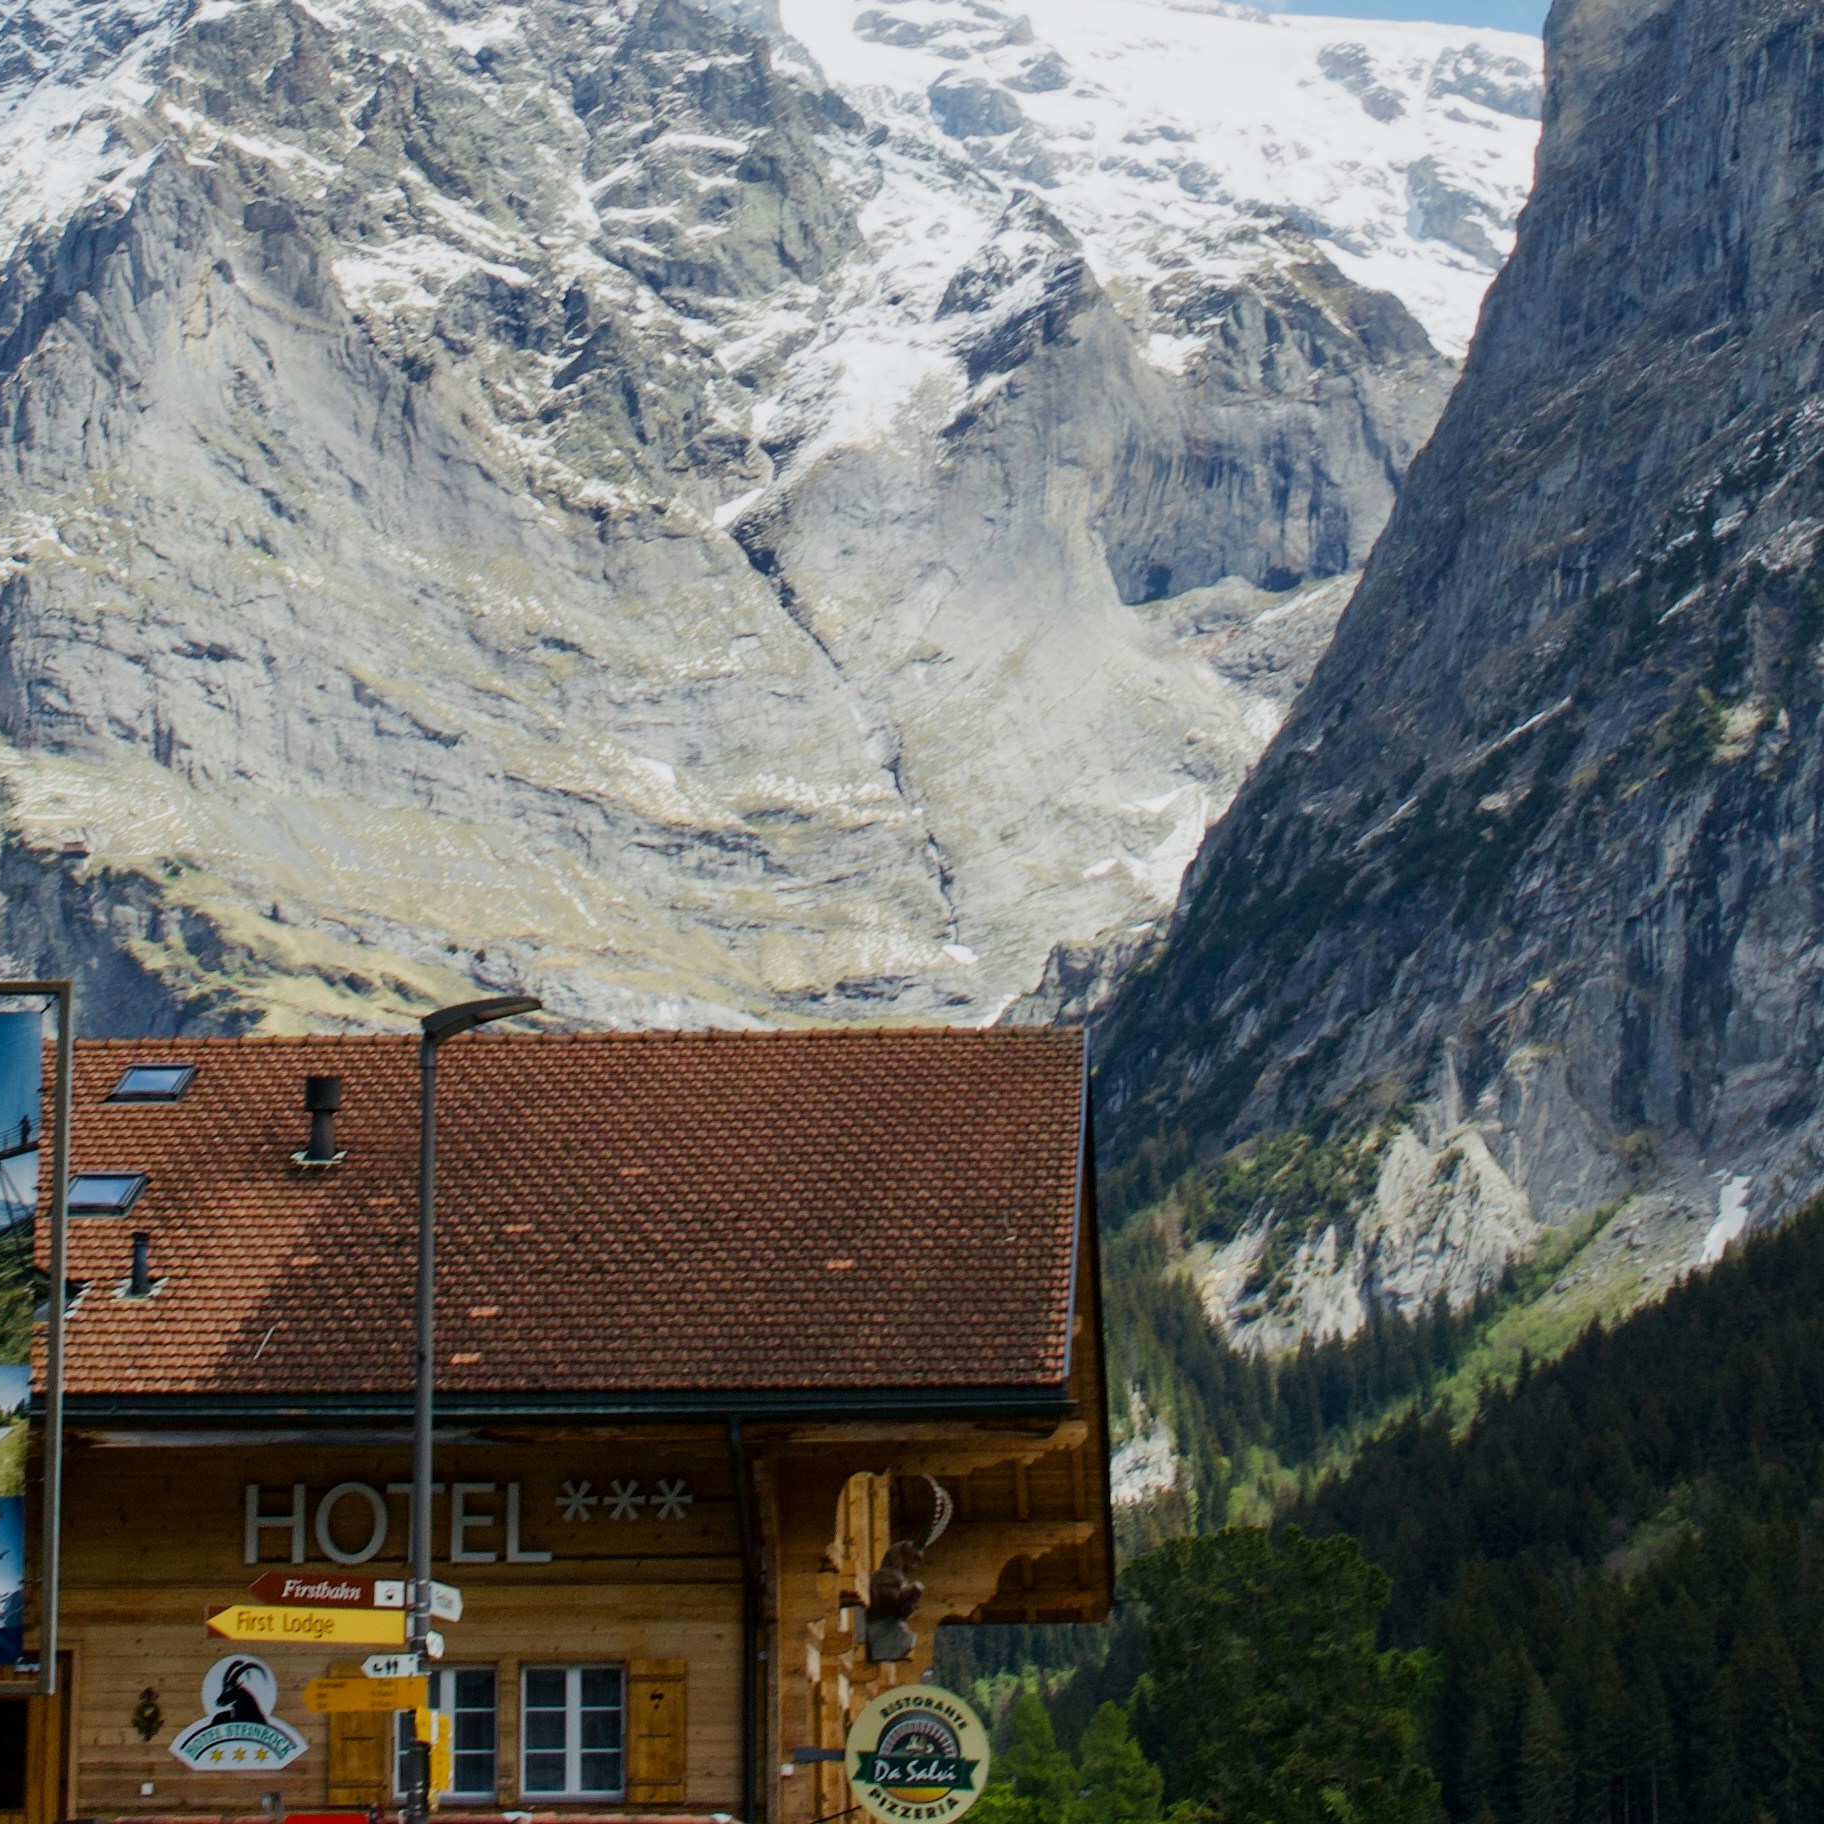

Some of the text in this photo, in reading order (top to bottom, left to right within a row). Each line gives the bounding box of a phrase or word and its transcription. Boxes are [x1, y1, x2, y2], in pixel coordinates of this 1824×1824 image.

[244, 1481, 554, 1565] HOTEL
[281, 1578, 362, 1601] Firstbahn
[236, 1611, 335, 1640] First Lodge
[879, 1696, 969, 1731] RISTORANTE
[873, 1759, 957, 1783] Da Salvi
[868, 1787, 960, 1820] PIZZERIA
